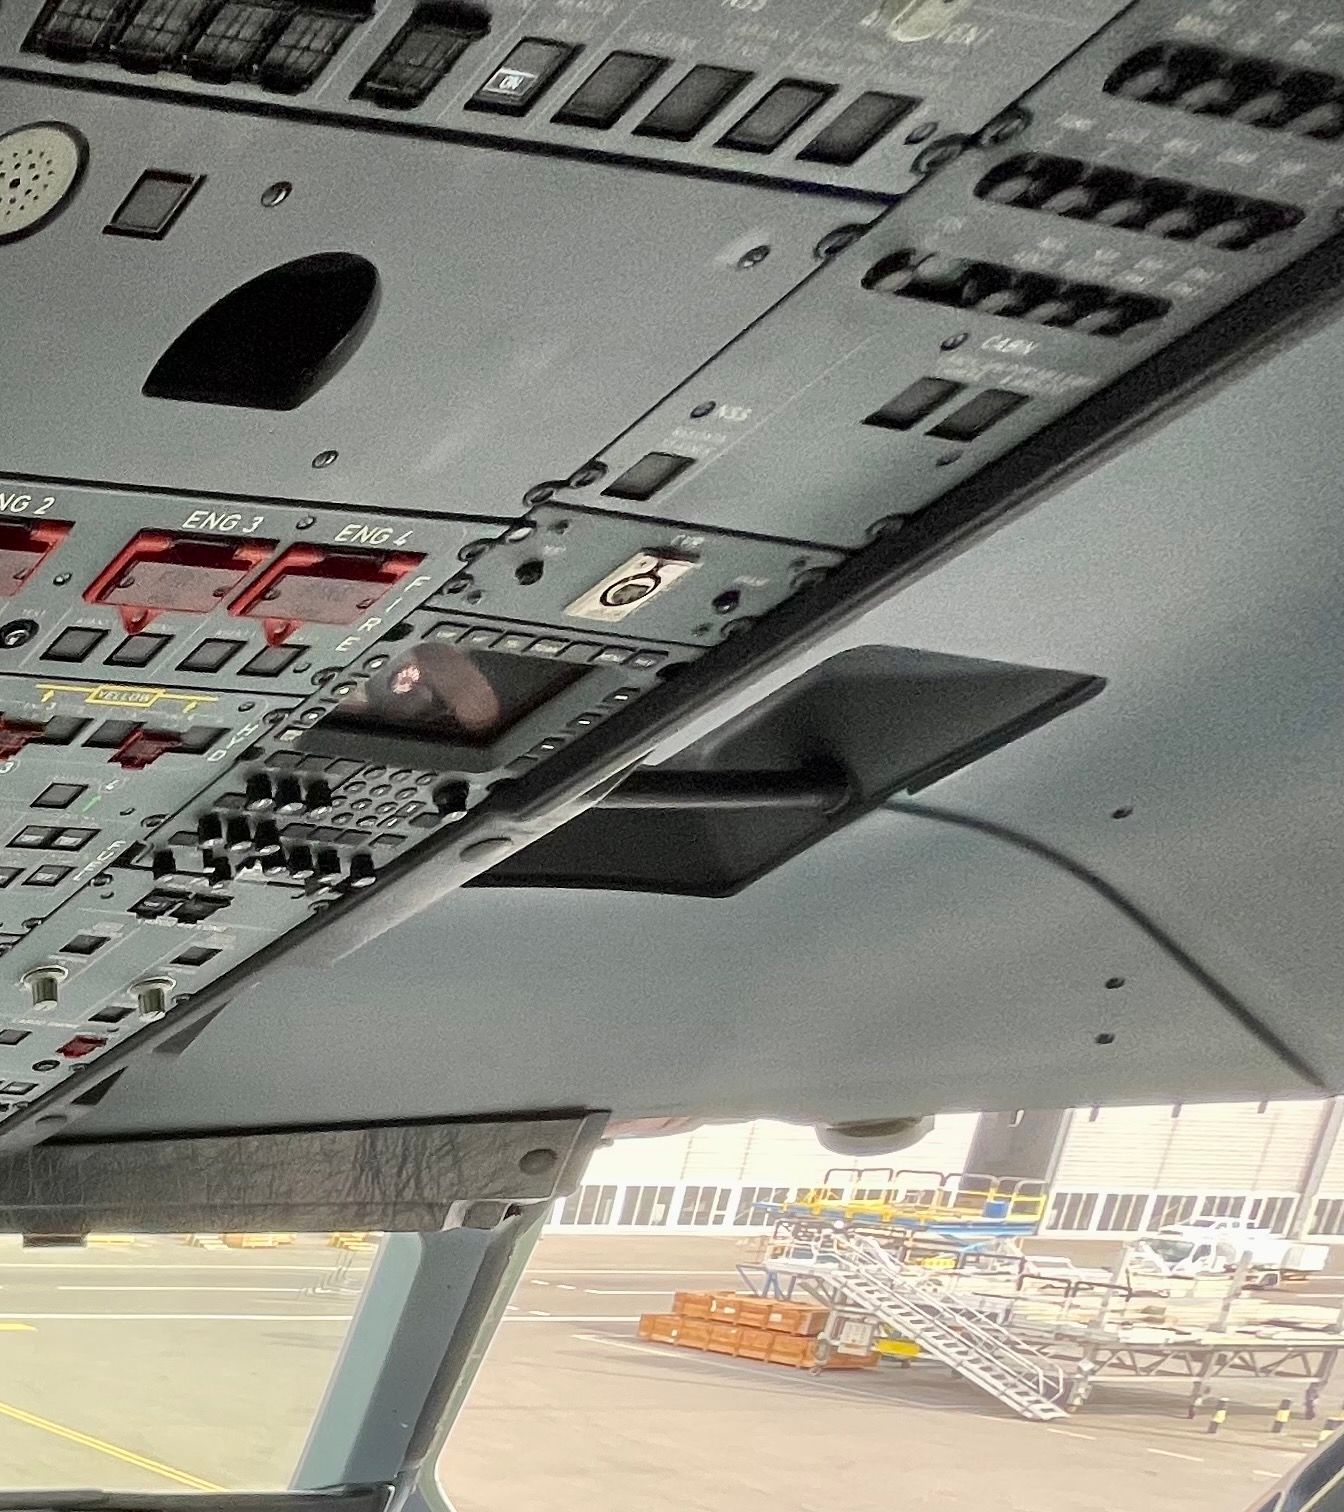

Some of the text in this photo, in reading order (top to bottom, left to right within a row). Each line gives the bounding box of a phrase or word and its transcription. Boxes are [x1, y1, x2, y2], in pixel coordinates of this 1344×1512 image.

[35, 495, 57, 516] 2
[182, 509, 264, 534] ENG 3
[333, 522, 413, 547] ENG 4
[333, 575, 432, 654] FIRE
